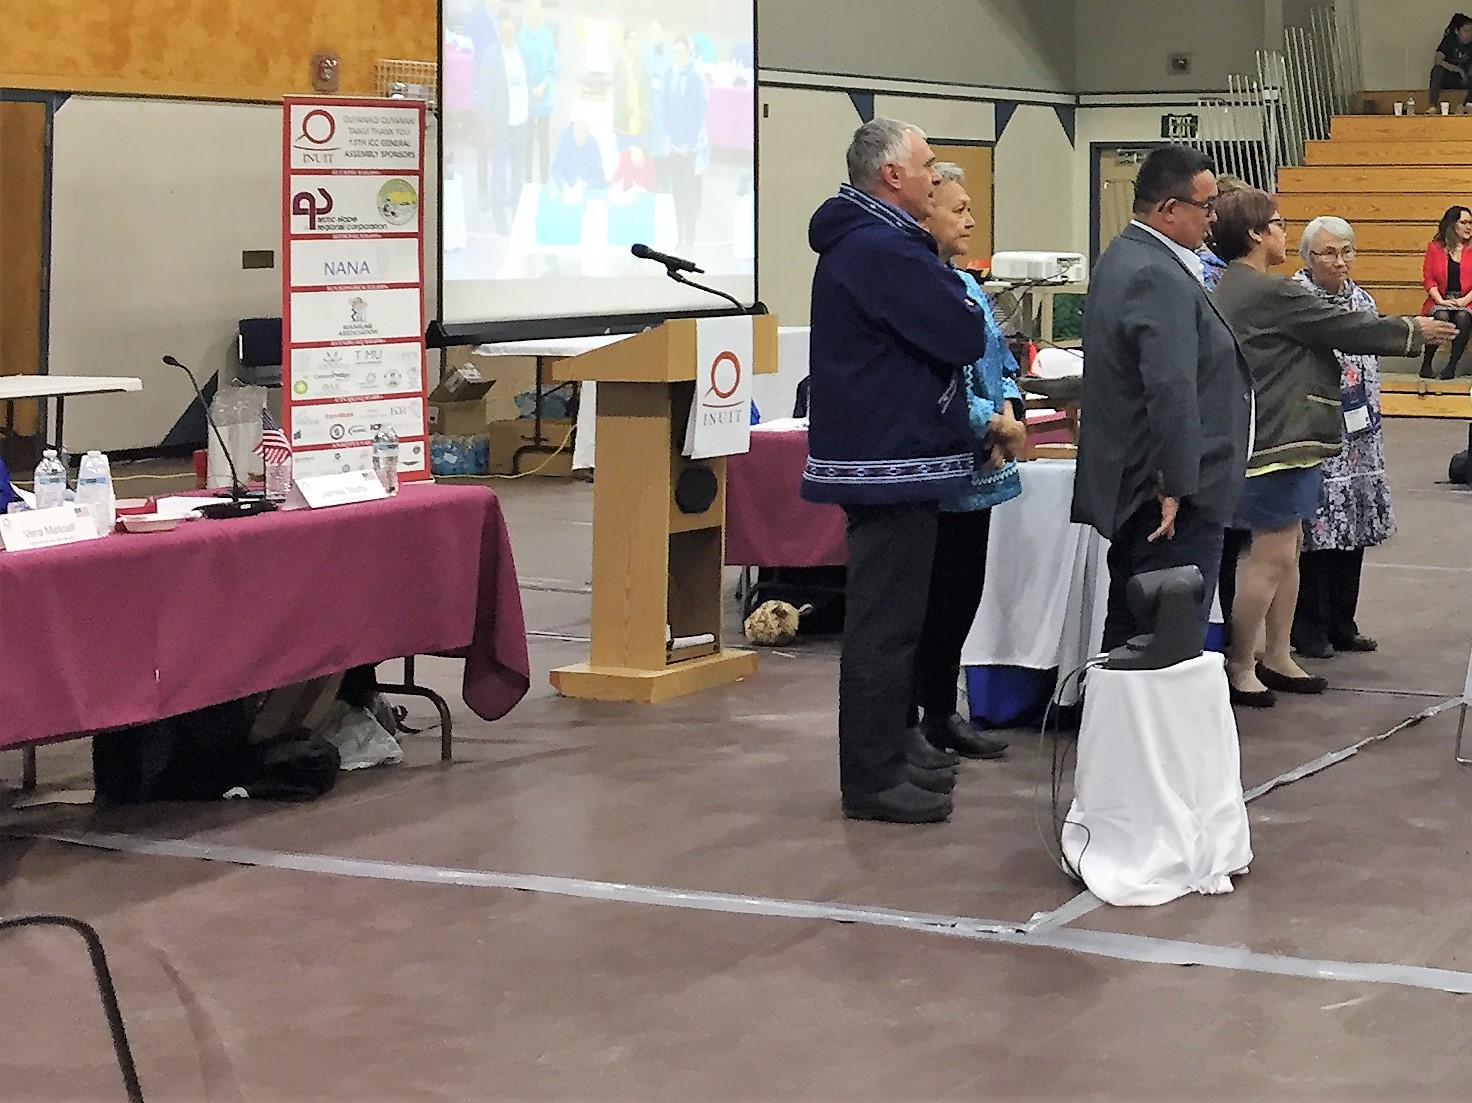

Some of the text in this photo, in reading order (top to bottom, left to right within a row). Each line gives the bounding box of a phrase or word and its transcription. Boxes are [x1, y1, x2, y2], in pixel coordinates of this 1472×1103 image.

[1169, 117, 1192, 137] EXIT
[380, 139, 411, 147] GENERAL
[303, 153, 334, 163] INUIT
[344, 150, 416, 158] ASSEMBLY SPONSORS
[324, 260, 371, 276] NANA
[704, 410, 742, 426] INUIT
